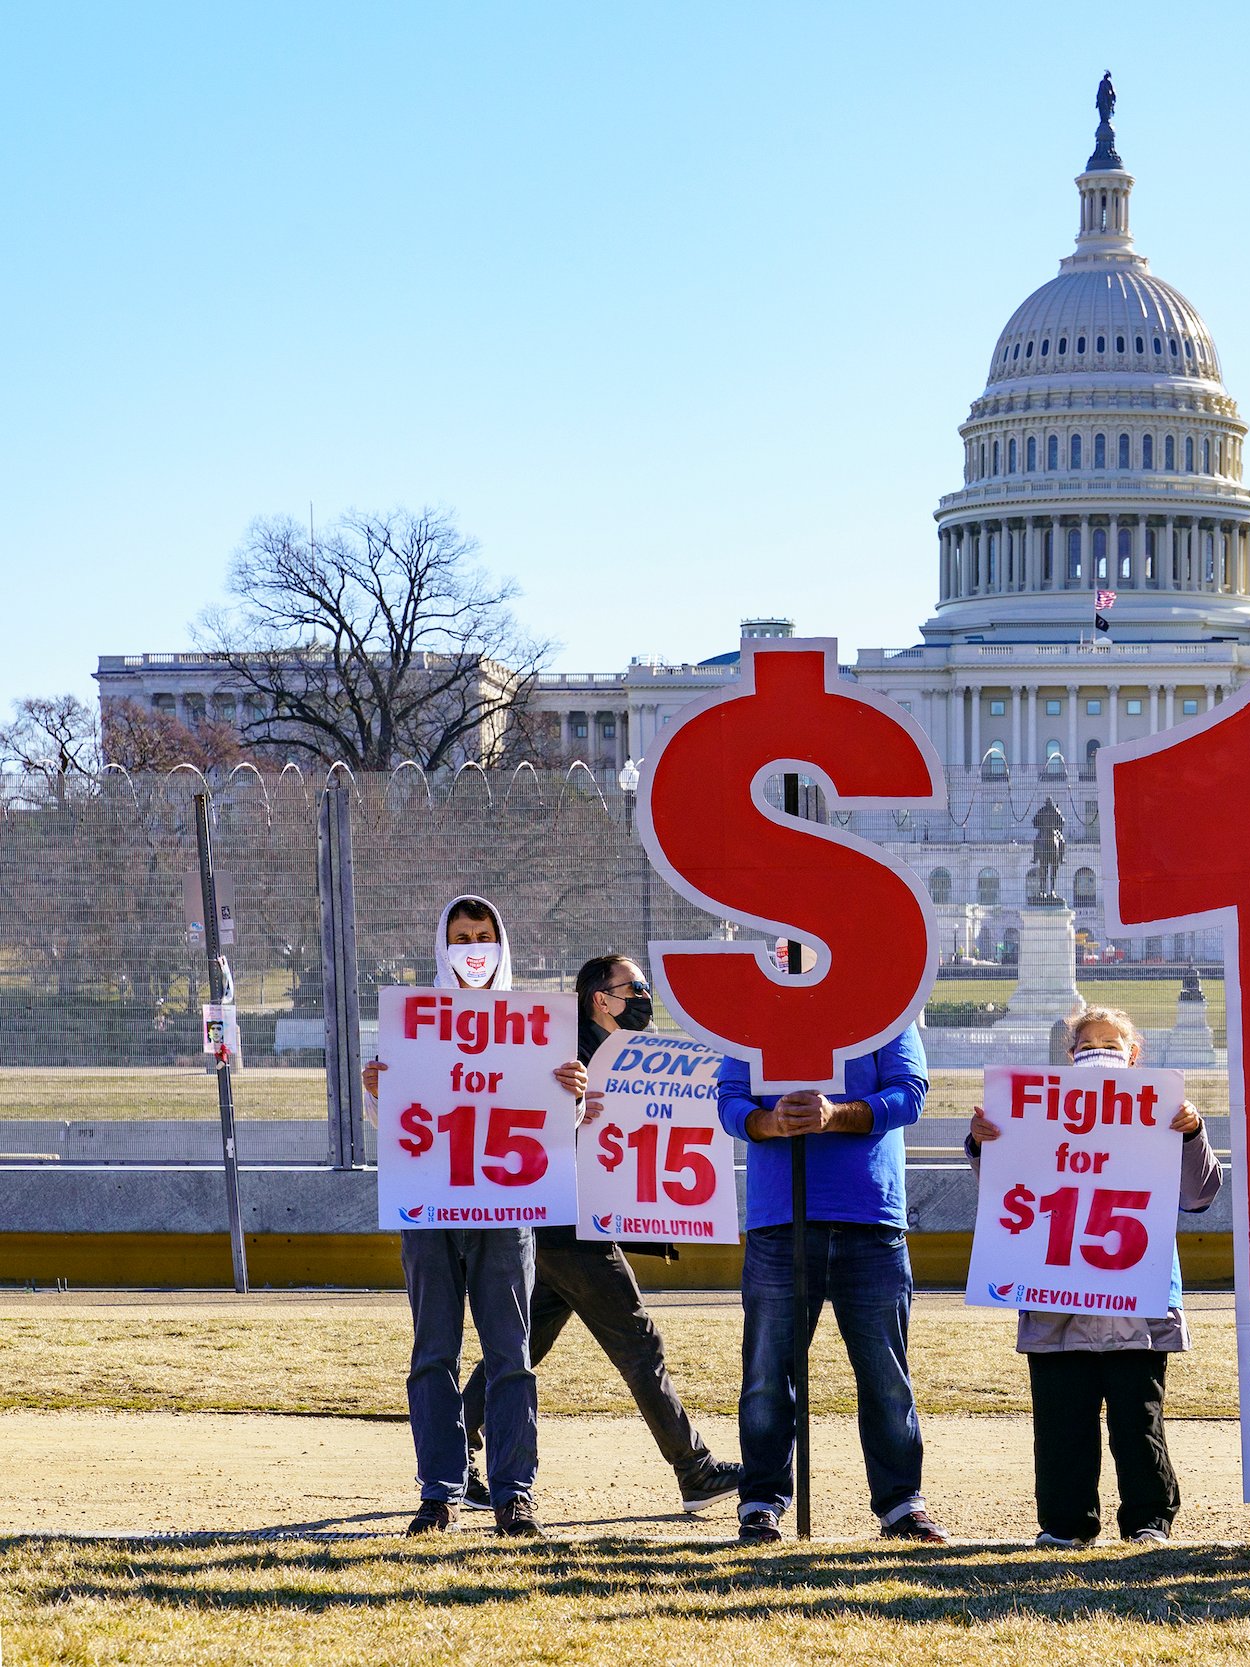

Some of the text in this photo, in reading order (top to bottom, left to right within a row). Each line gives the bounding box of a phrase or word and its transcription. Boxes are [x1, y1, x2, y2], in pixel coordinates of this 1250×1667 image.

[405, 997, 549, 1054] Fight
[450, 1062, 503, 1093] for
[605, 1078, 719, 1100] BACKTRACK
[645, 1102, 673, 1119] ON
[1011, 1074, 1158, 1134] Fight
[399, 1103, 549, 1186] $15
[1056, 1142, 1110, 1173] for
[596, 1122, 716, 1206] $15
[427, 1206, 546, 1222] OUR REVOLUTION
[623, 1217, 714, 1237] REVOLUTION
[1000, 1184, 1152, 1270] $15
[1016, 1284, 1137, 1311] OUR REVOLUTION
